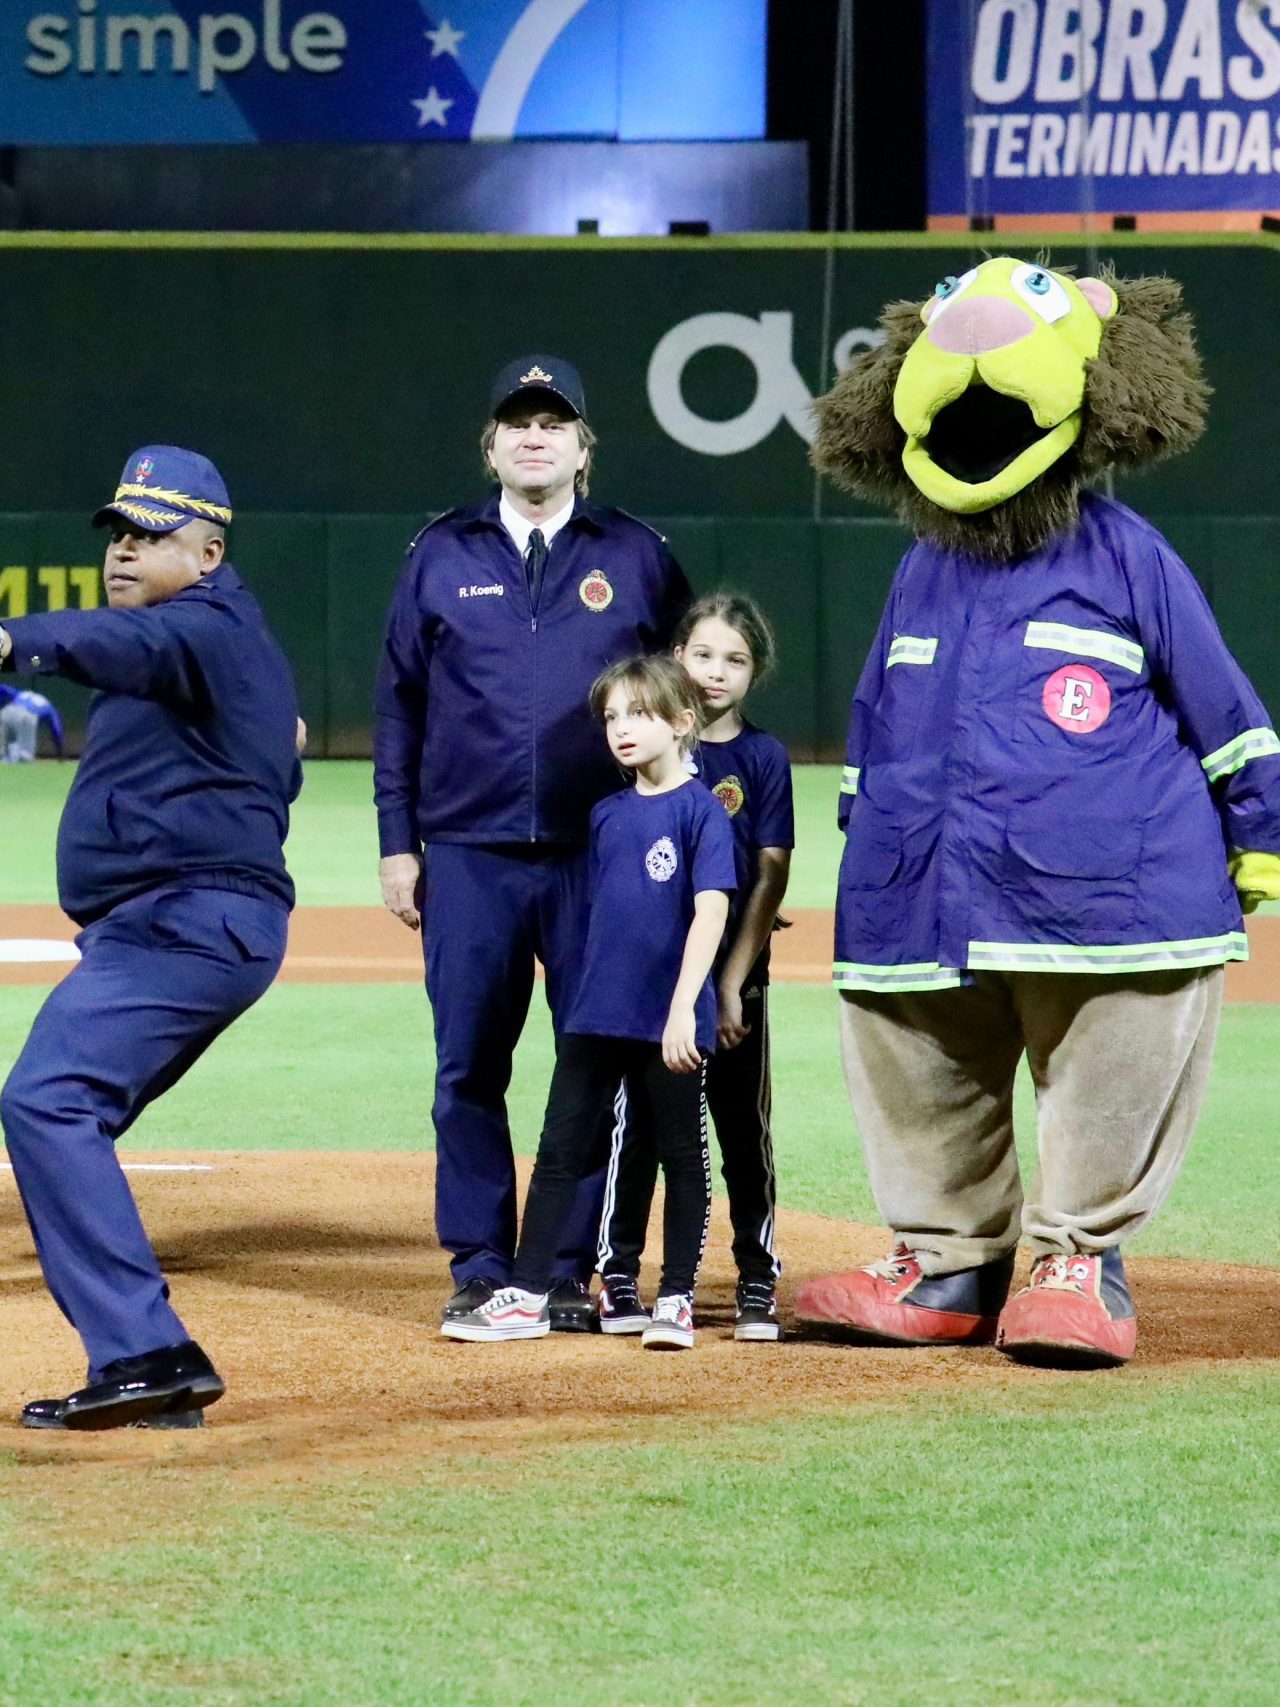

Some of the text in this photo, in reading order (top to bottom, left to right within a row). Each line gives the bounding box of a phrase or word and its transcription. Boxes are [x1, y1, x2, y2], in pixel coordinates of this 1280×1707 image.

[25, 0, 348, 92] simple
[971, 0, 1280, 104] OBRAS
[969, 110, 1280, 178] TERMINADA
[459, 583, 504, 598] R. Koenig
[1059, 677, 1093, 721] E
[699, 1092, 707, 1143] GUESS
[701, 1148, 712, 1199] GUESS
